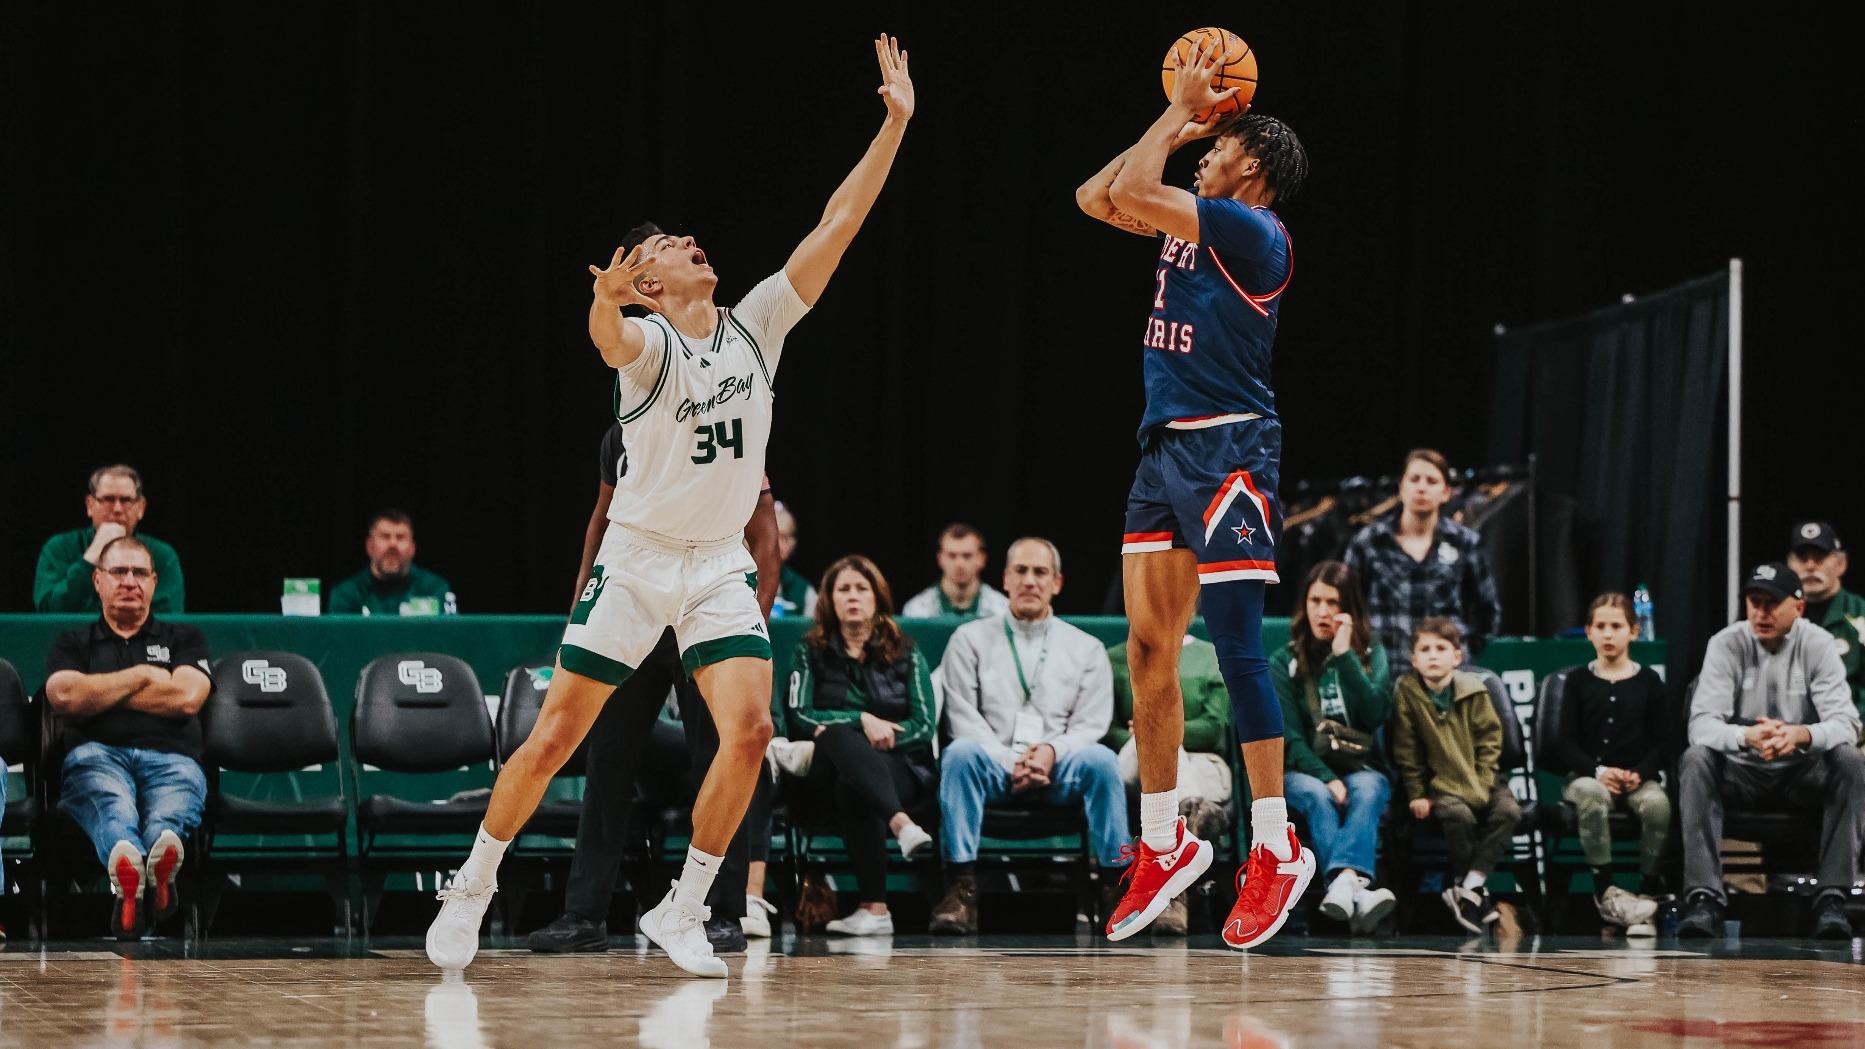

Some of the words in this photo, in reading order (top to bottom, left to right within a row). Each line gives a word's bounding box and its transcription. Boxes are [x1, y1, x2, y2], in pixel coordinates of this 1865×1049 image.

[715, 372, 755, 405] Bay
[690, 417, 744, 465] 34
[242, 659, 287, 692] GB
[397, 660, 444, 694] GB
